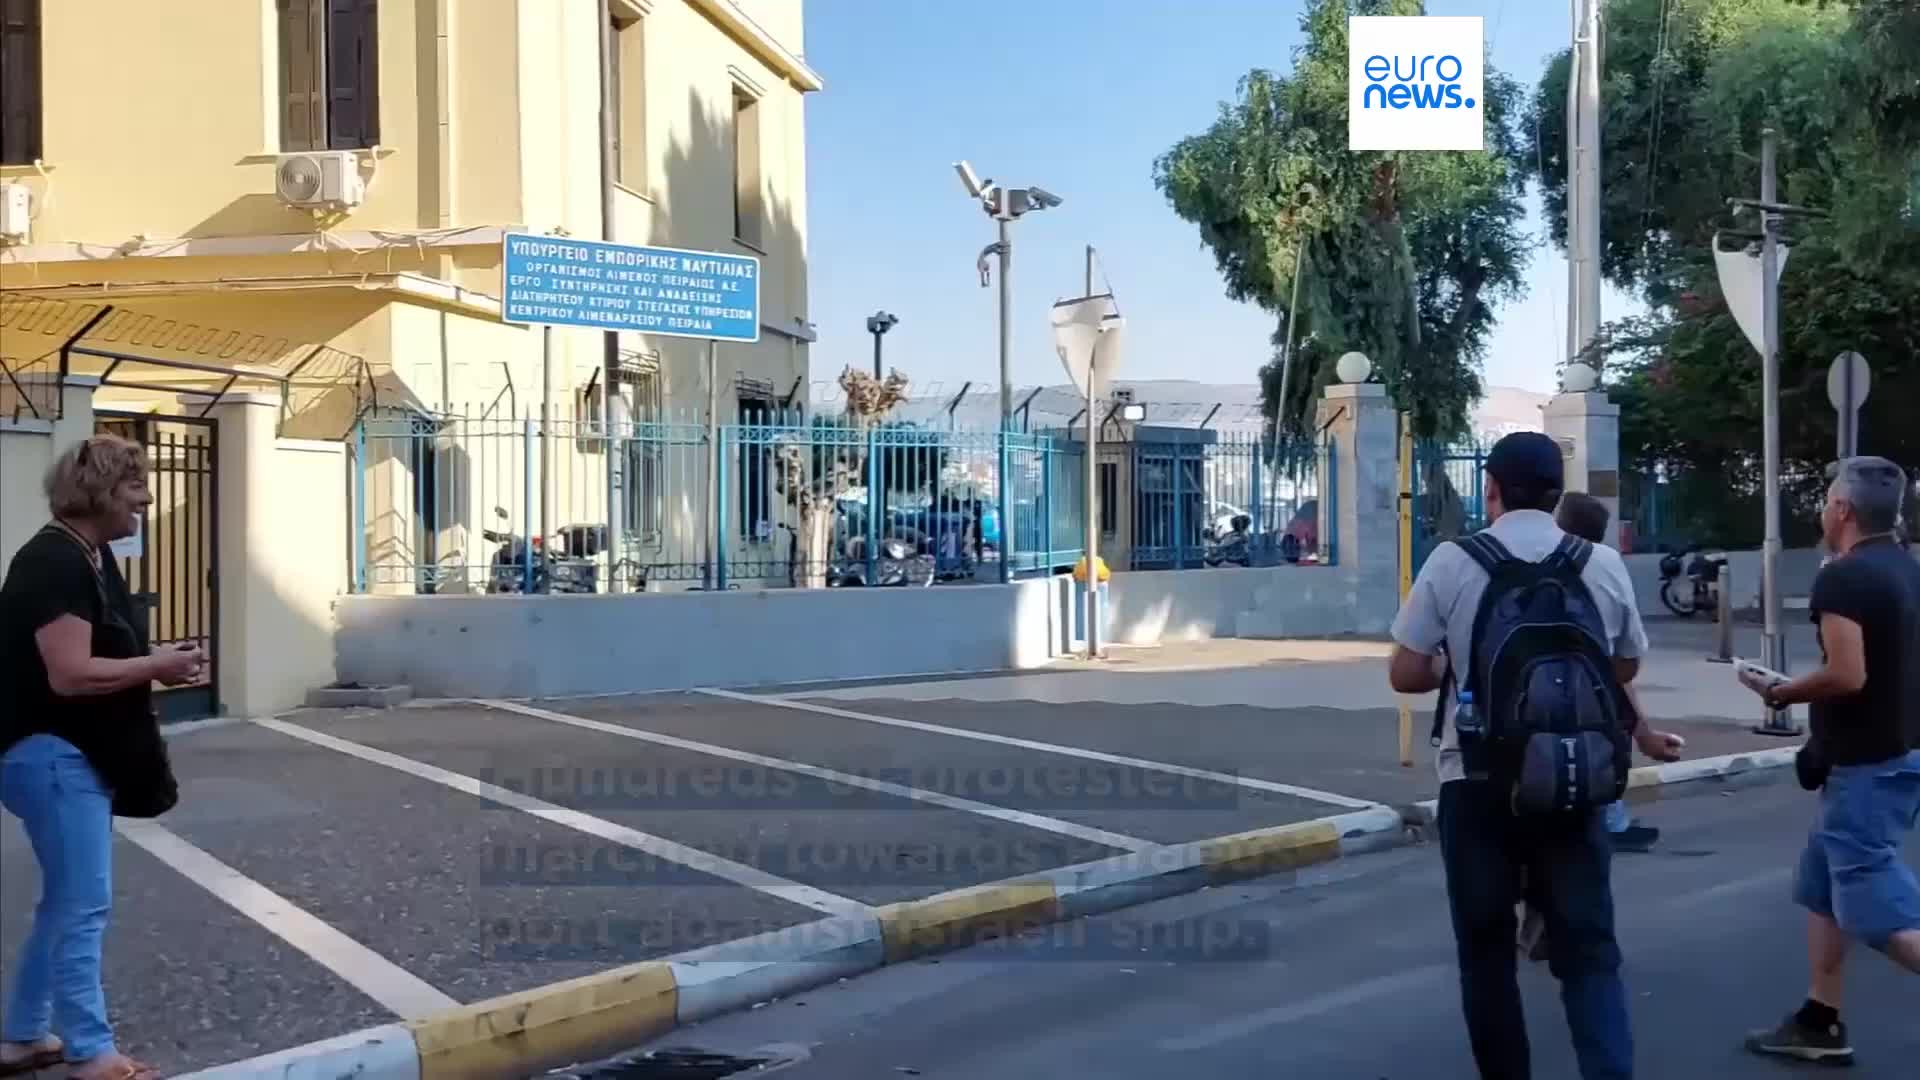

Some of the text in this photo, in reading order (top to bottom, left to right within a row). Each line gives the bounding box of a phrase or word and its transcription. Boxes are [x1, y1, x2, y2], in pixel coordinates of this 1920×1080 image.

[511, 241, 753, 278] ΥΠΟΥΡΓΕΙΟ ΕΜΠΟΡΙΚΗΣ ΝΑΥΤΙΛΙΑΣ
[510, 275, 541, 286] ΕΡΓΟ
[552, 279, 628, 295] ΣΥΝΤΗΡΗΣΗΣ
[634, 286, 652, 297] ΚΑΙ
[527, 262, 601, 278] ΟΡΓΑΝΙΣΜΟΣ
[606, 270, 657, 283] ΛΙΜΕΝΟΣ
[662, 275, 715, 289] ΠΕΙΡΑΙΩΣ
[510, 304, 712, 329] ΚΕΝΤΡΙΚΟΥ ΛΙΜΕΝΑΡΧΕΙΟΥ ΠΕΙΡΑΙΑ
[638, 301, 691, 315] ΣΤΕΓΑΣΗΣ
[694, 306, 753, 320] ΥΠΗΡΕΣΙΩΝ
